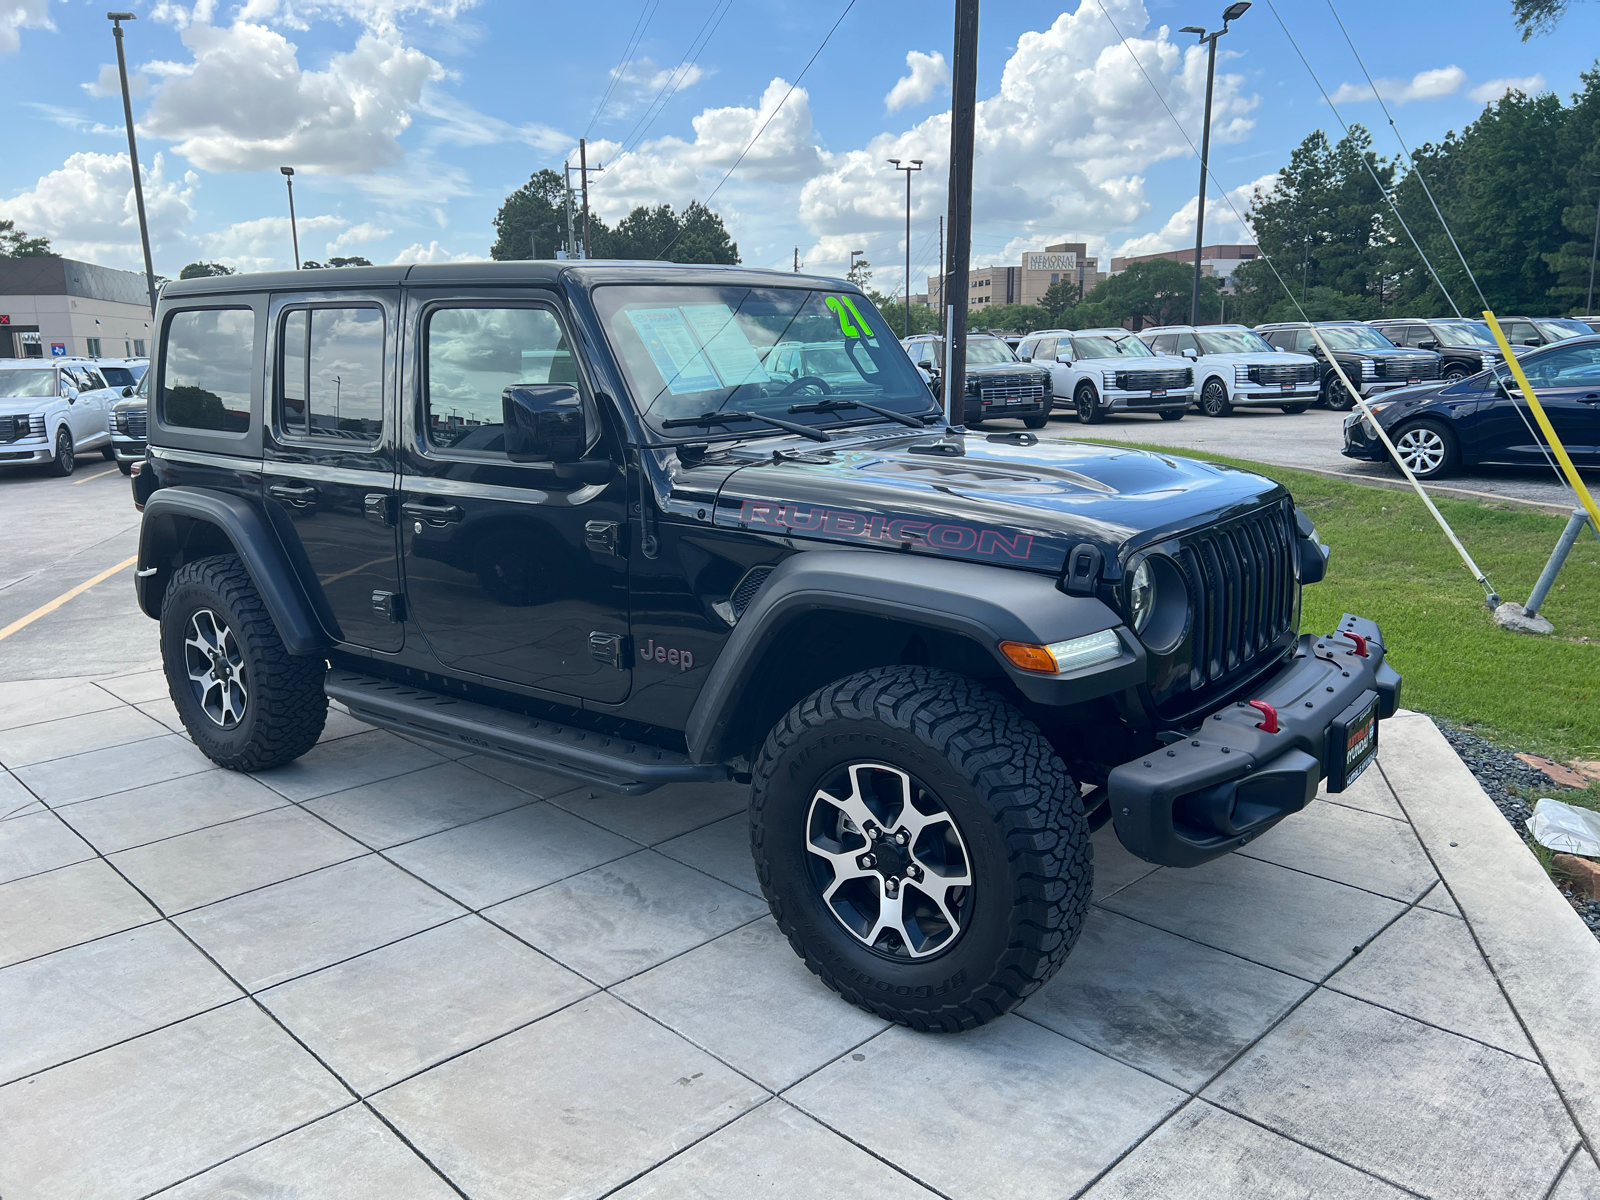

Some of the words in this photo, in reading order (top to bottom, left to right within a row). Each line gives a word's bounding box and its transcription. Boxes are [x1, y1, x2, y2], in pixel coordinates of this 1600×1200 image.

[1030, 255, 1074, 263] MEMORIAL
[1030, 262, 1074, 270] HERMANN
[825, 295, 875, 339] 21
[739, 499, 1034, 560] RUBICON
[640, 639, 694, 672] Jeep
[788, 731, 928, 780] All-Terrain
[804, 923, 969, 1001] BFGoodrich
